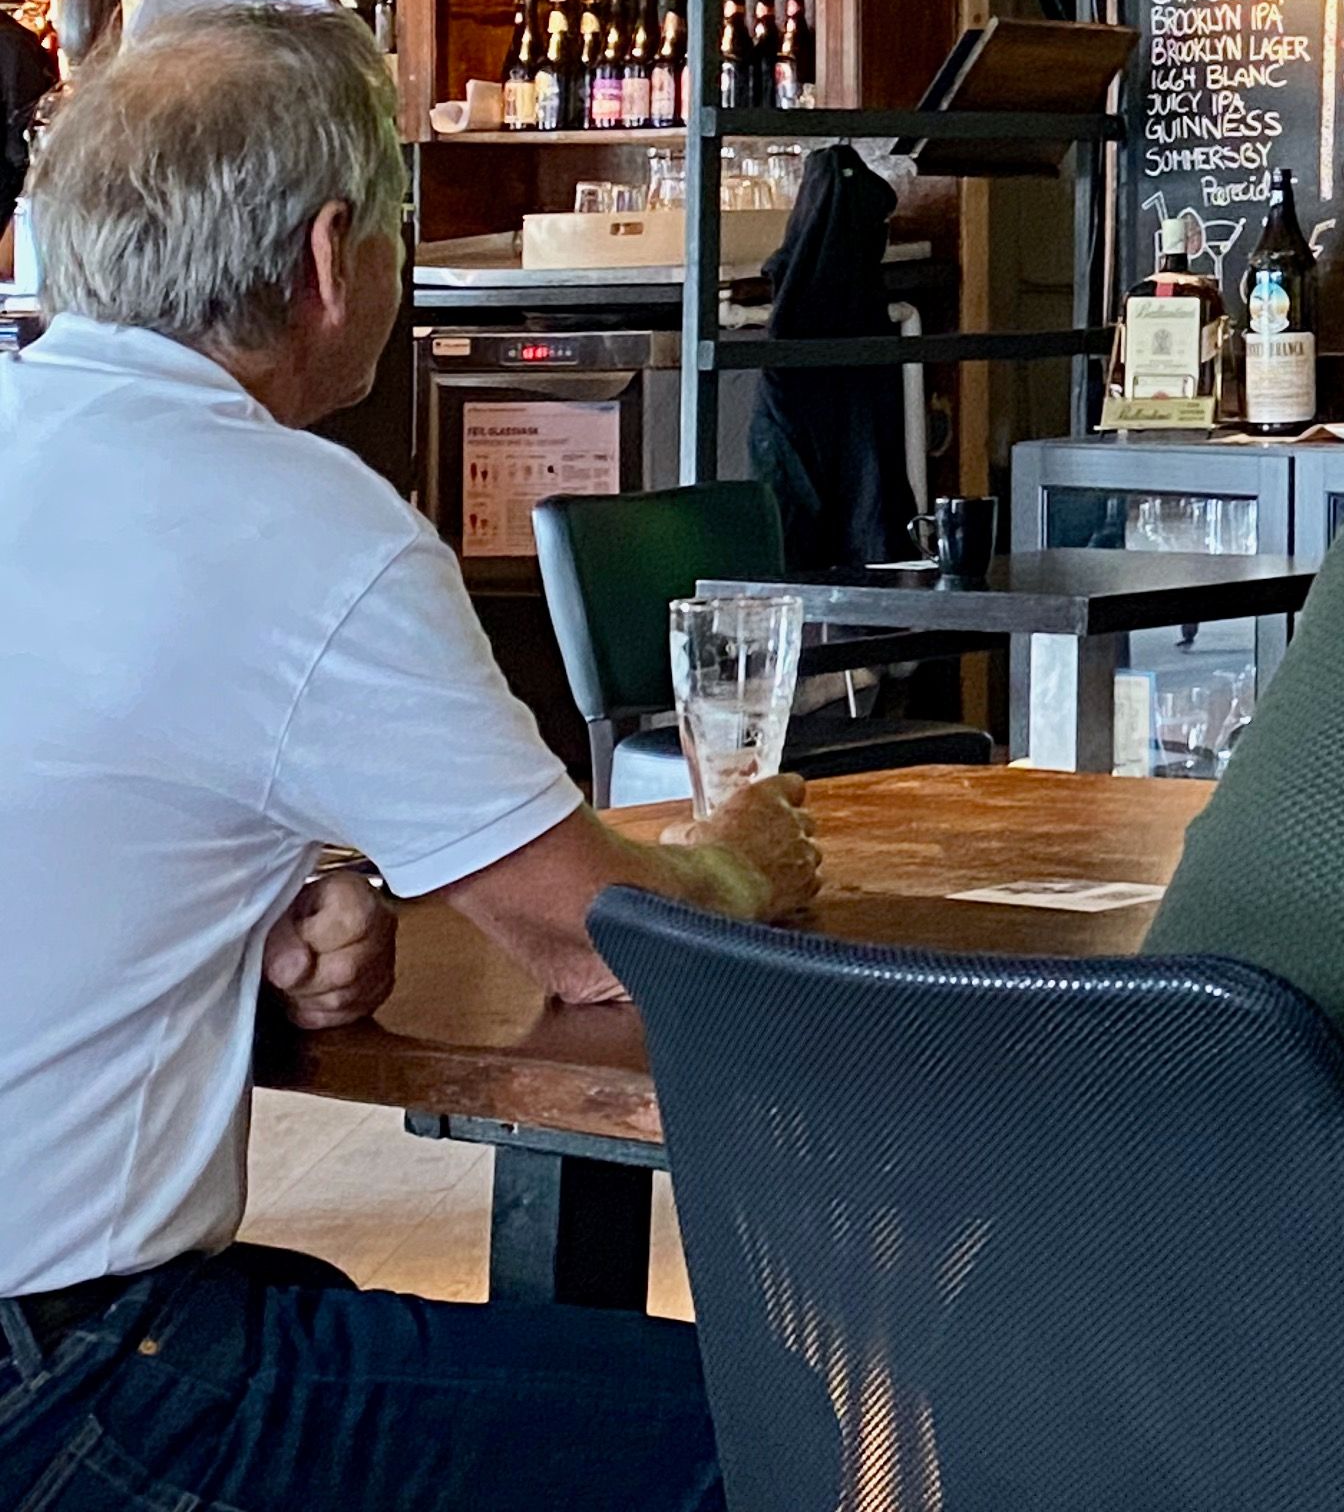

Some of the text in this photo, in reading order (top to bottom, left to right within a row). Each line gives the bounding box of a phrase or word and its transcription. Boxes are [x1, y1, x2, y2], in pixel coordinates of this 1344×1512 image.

[1150, 1, 1285, 36] BROOKLYN IPA
[1150, 32, 1312, 67] BROOKLYN LAGER
[1151, 63, 1288, 92] 1664 BLANC
[1147, 89, 1249, 117] JUICY IPA
[1145, 108, 1284, 145] GUINNESS
[1144, 140, 1274, 177] SOMMERSBY
